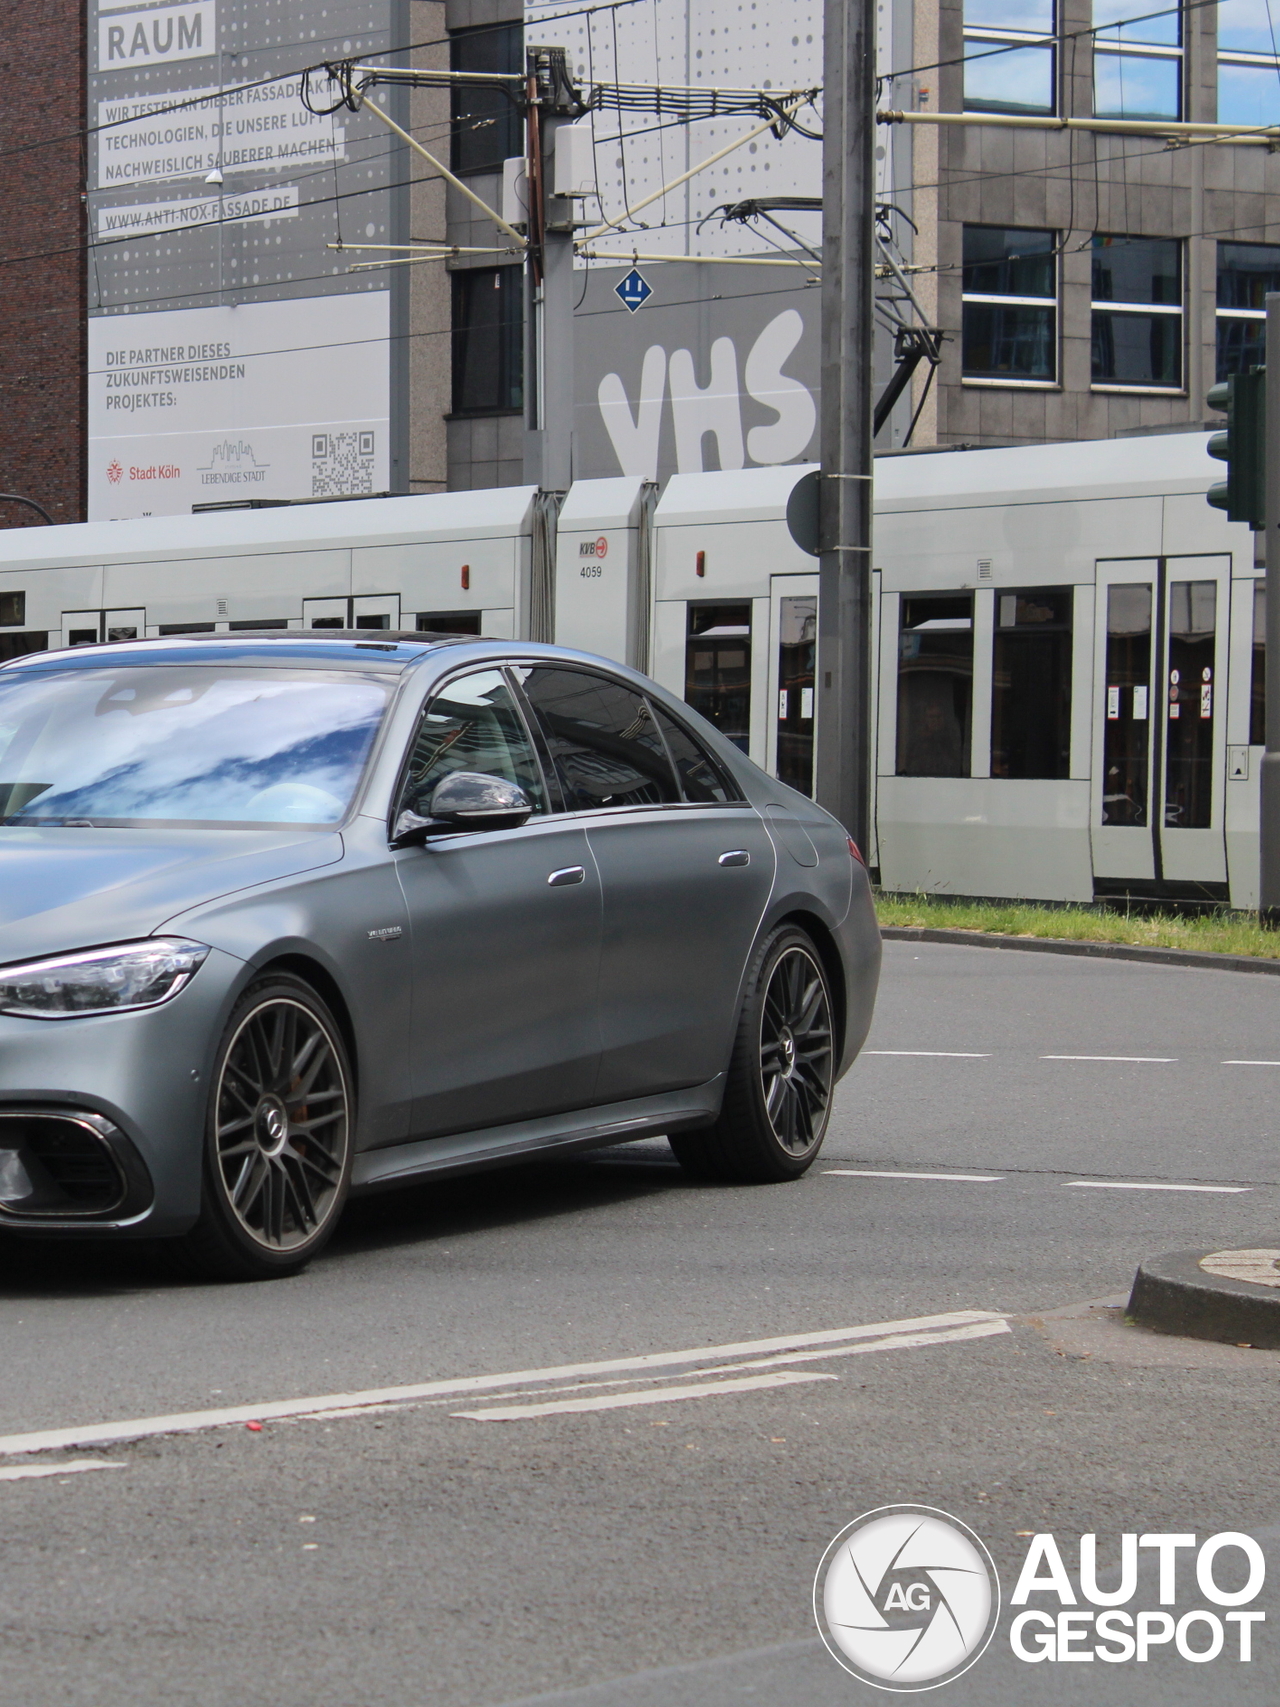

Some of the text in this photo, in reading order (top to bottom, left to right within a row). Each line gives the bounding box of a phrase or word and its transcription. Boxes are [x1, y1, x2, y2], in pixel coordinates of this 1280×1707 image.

[108, 13, 202, 60] RAUM
[106, 106, 129, 122] WIR
[132, 100, 176, 119] TESTEN
[180, 97, 197, 112] AN
[201, 91, 243, 109] DIESER
[247, 81, 302, 103] FASSADE
[106, 109, 322, 150] TECHNOLOGIEN, DIE UNSERE LUFT
[106, 138, 339, 179] NACHWEISLICH SAUBERER MACHEN.
[106, 195, 290, 229] WWW.ANTI-NOX-FASSADE.DE
[106, 343, 231, 366] DIE PARTNER DIESES
[106, 364, 245, 388] ZUKUNFTSWEISENDEN
[106, 392, 177, 412] PROJEKTES:
[598, 309, 816, 483] VHS
[129, 464, 180, 481] Stadt Köln
[202, 471, 265, 484] LEBENDIGE STADT
[580, 542, 595, 555] KVB
[580, 566, 602, 578] 4059
